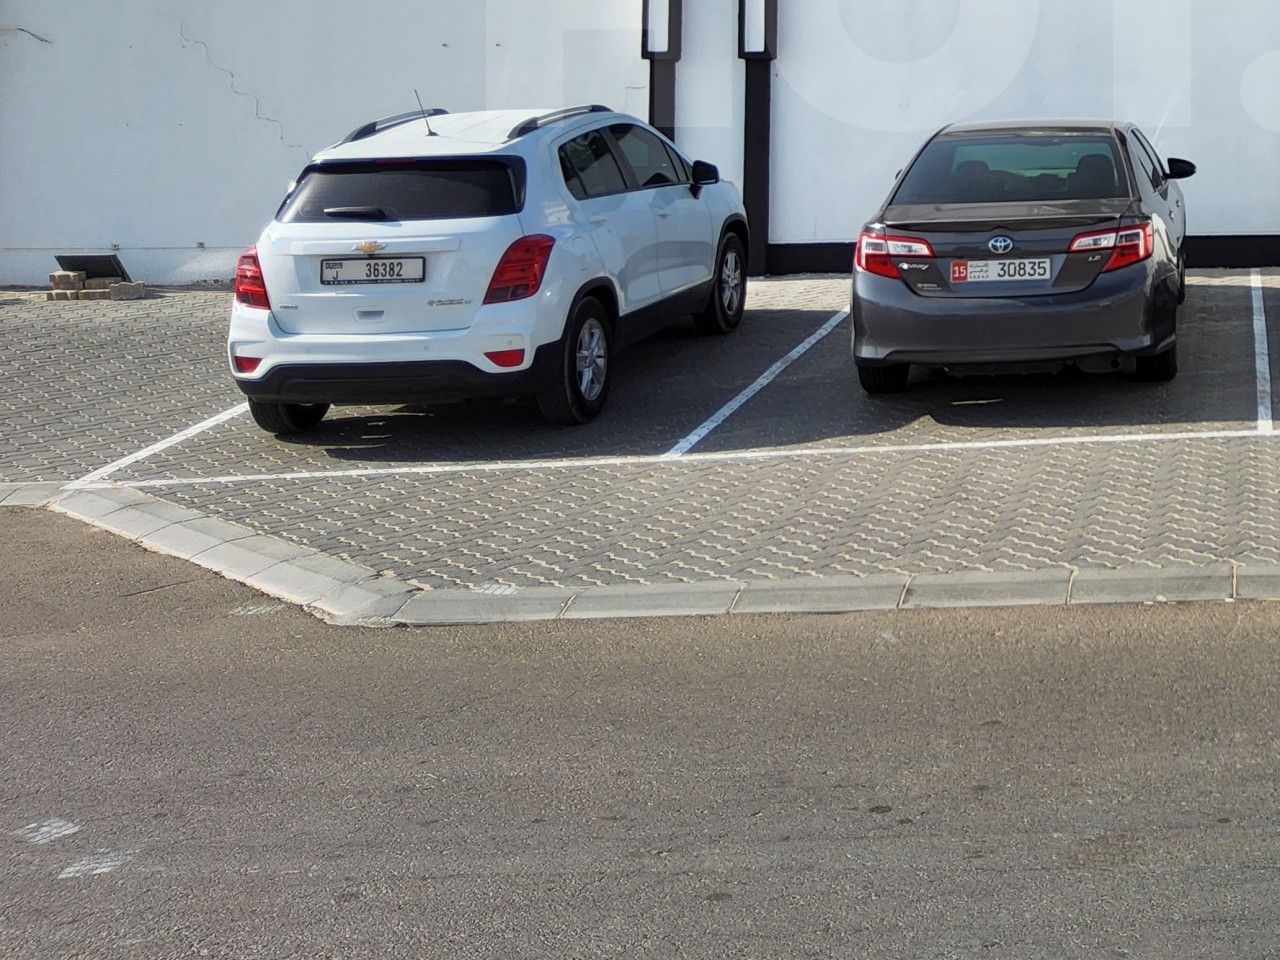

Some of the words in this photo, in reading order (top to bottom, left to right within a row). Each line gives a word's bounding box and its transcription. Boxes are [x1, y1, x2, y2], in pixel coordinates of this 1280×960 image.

[332, 271, 339, 280] J
[365, 262, 403, 278] 36382
[953, 266, 967, 280] 15
[997, 261, 1047, 278] 30835
